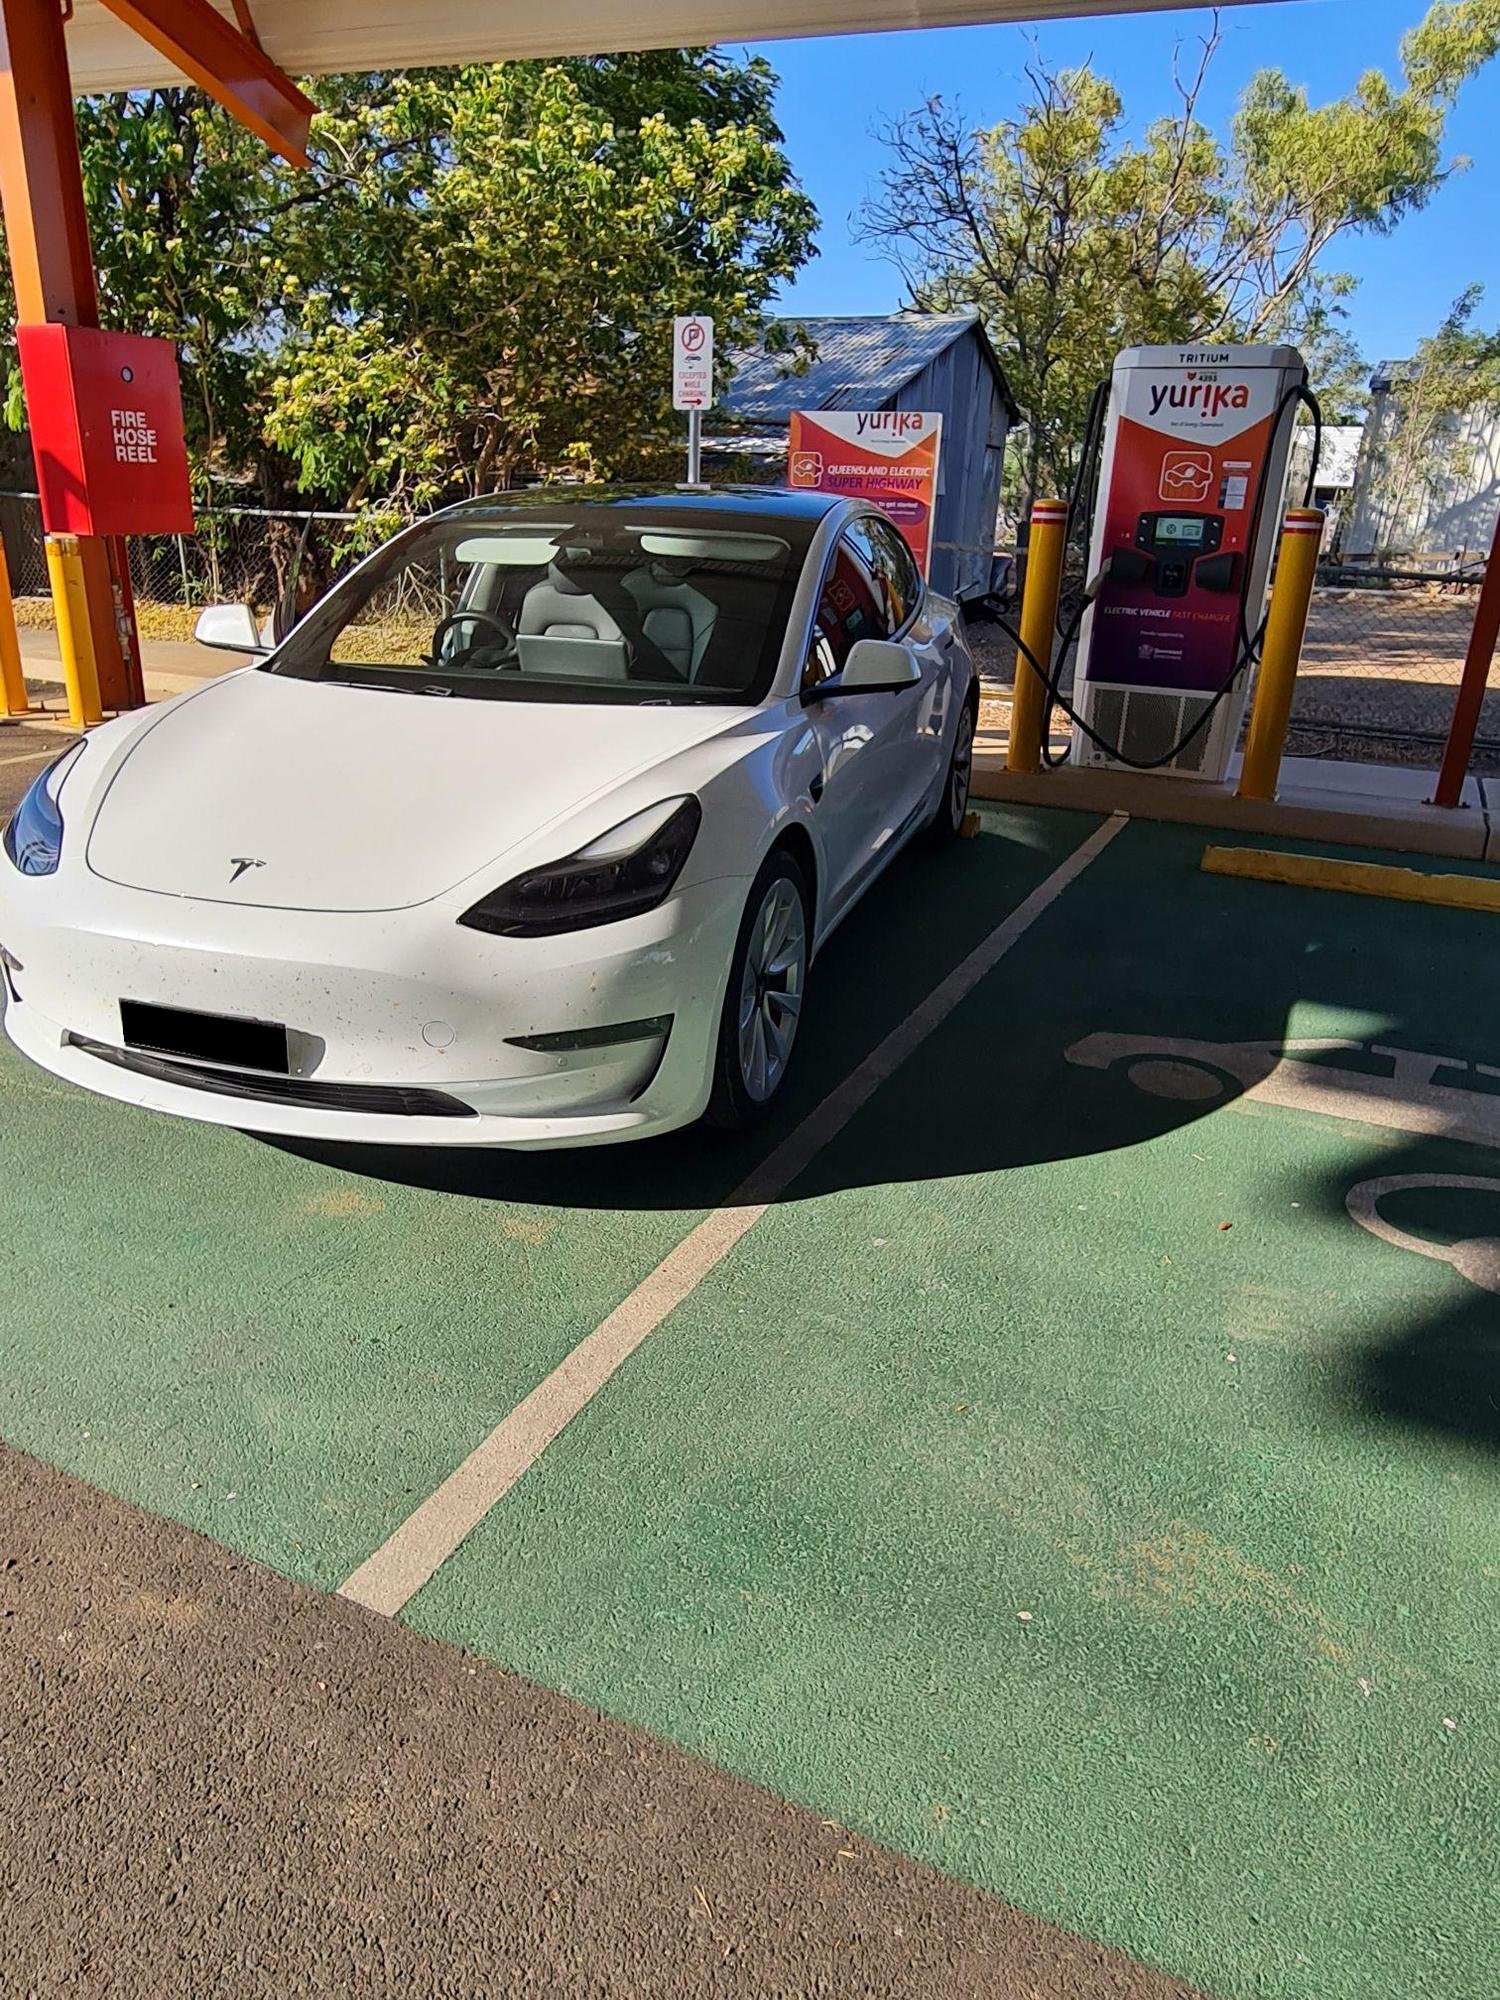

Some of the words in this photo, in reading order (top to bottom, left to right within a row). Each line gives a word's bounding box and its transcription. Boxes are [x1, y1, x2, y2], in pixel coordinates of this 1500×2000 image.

[1179, 353, 1230, 363] TRITIUM
[1149, 384, 1249, 418] yurika
[111, 410, 148, 428] FIRE
[857, 412, 923, 437] yurika
[113, 428, 158, 446] HOSE
[115, 446, 158, 463] REEL
[827, 465, 888, 476] QUEENSLAND
[889, 466, 931, 477] ELECTRIC
[827, 477, 863, 488] SUPER
[865, 478, 923, 490] HIGHWAY
[1104, 606, 1139, 616] ELECTRIC
[1139, 607, 1171, 618] VEHICLE
[1172, 610, 1191, 620] FAST
[1193, 612, 1231, 623] CHARGER
